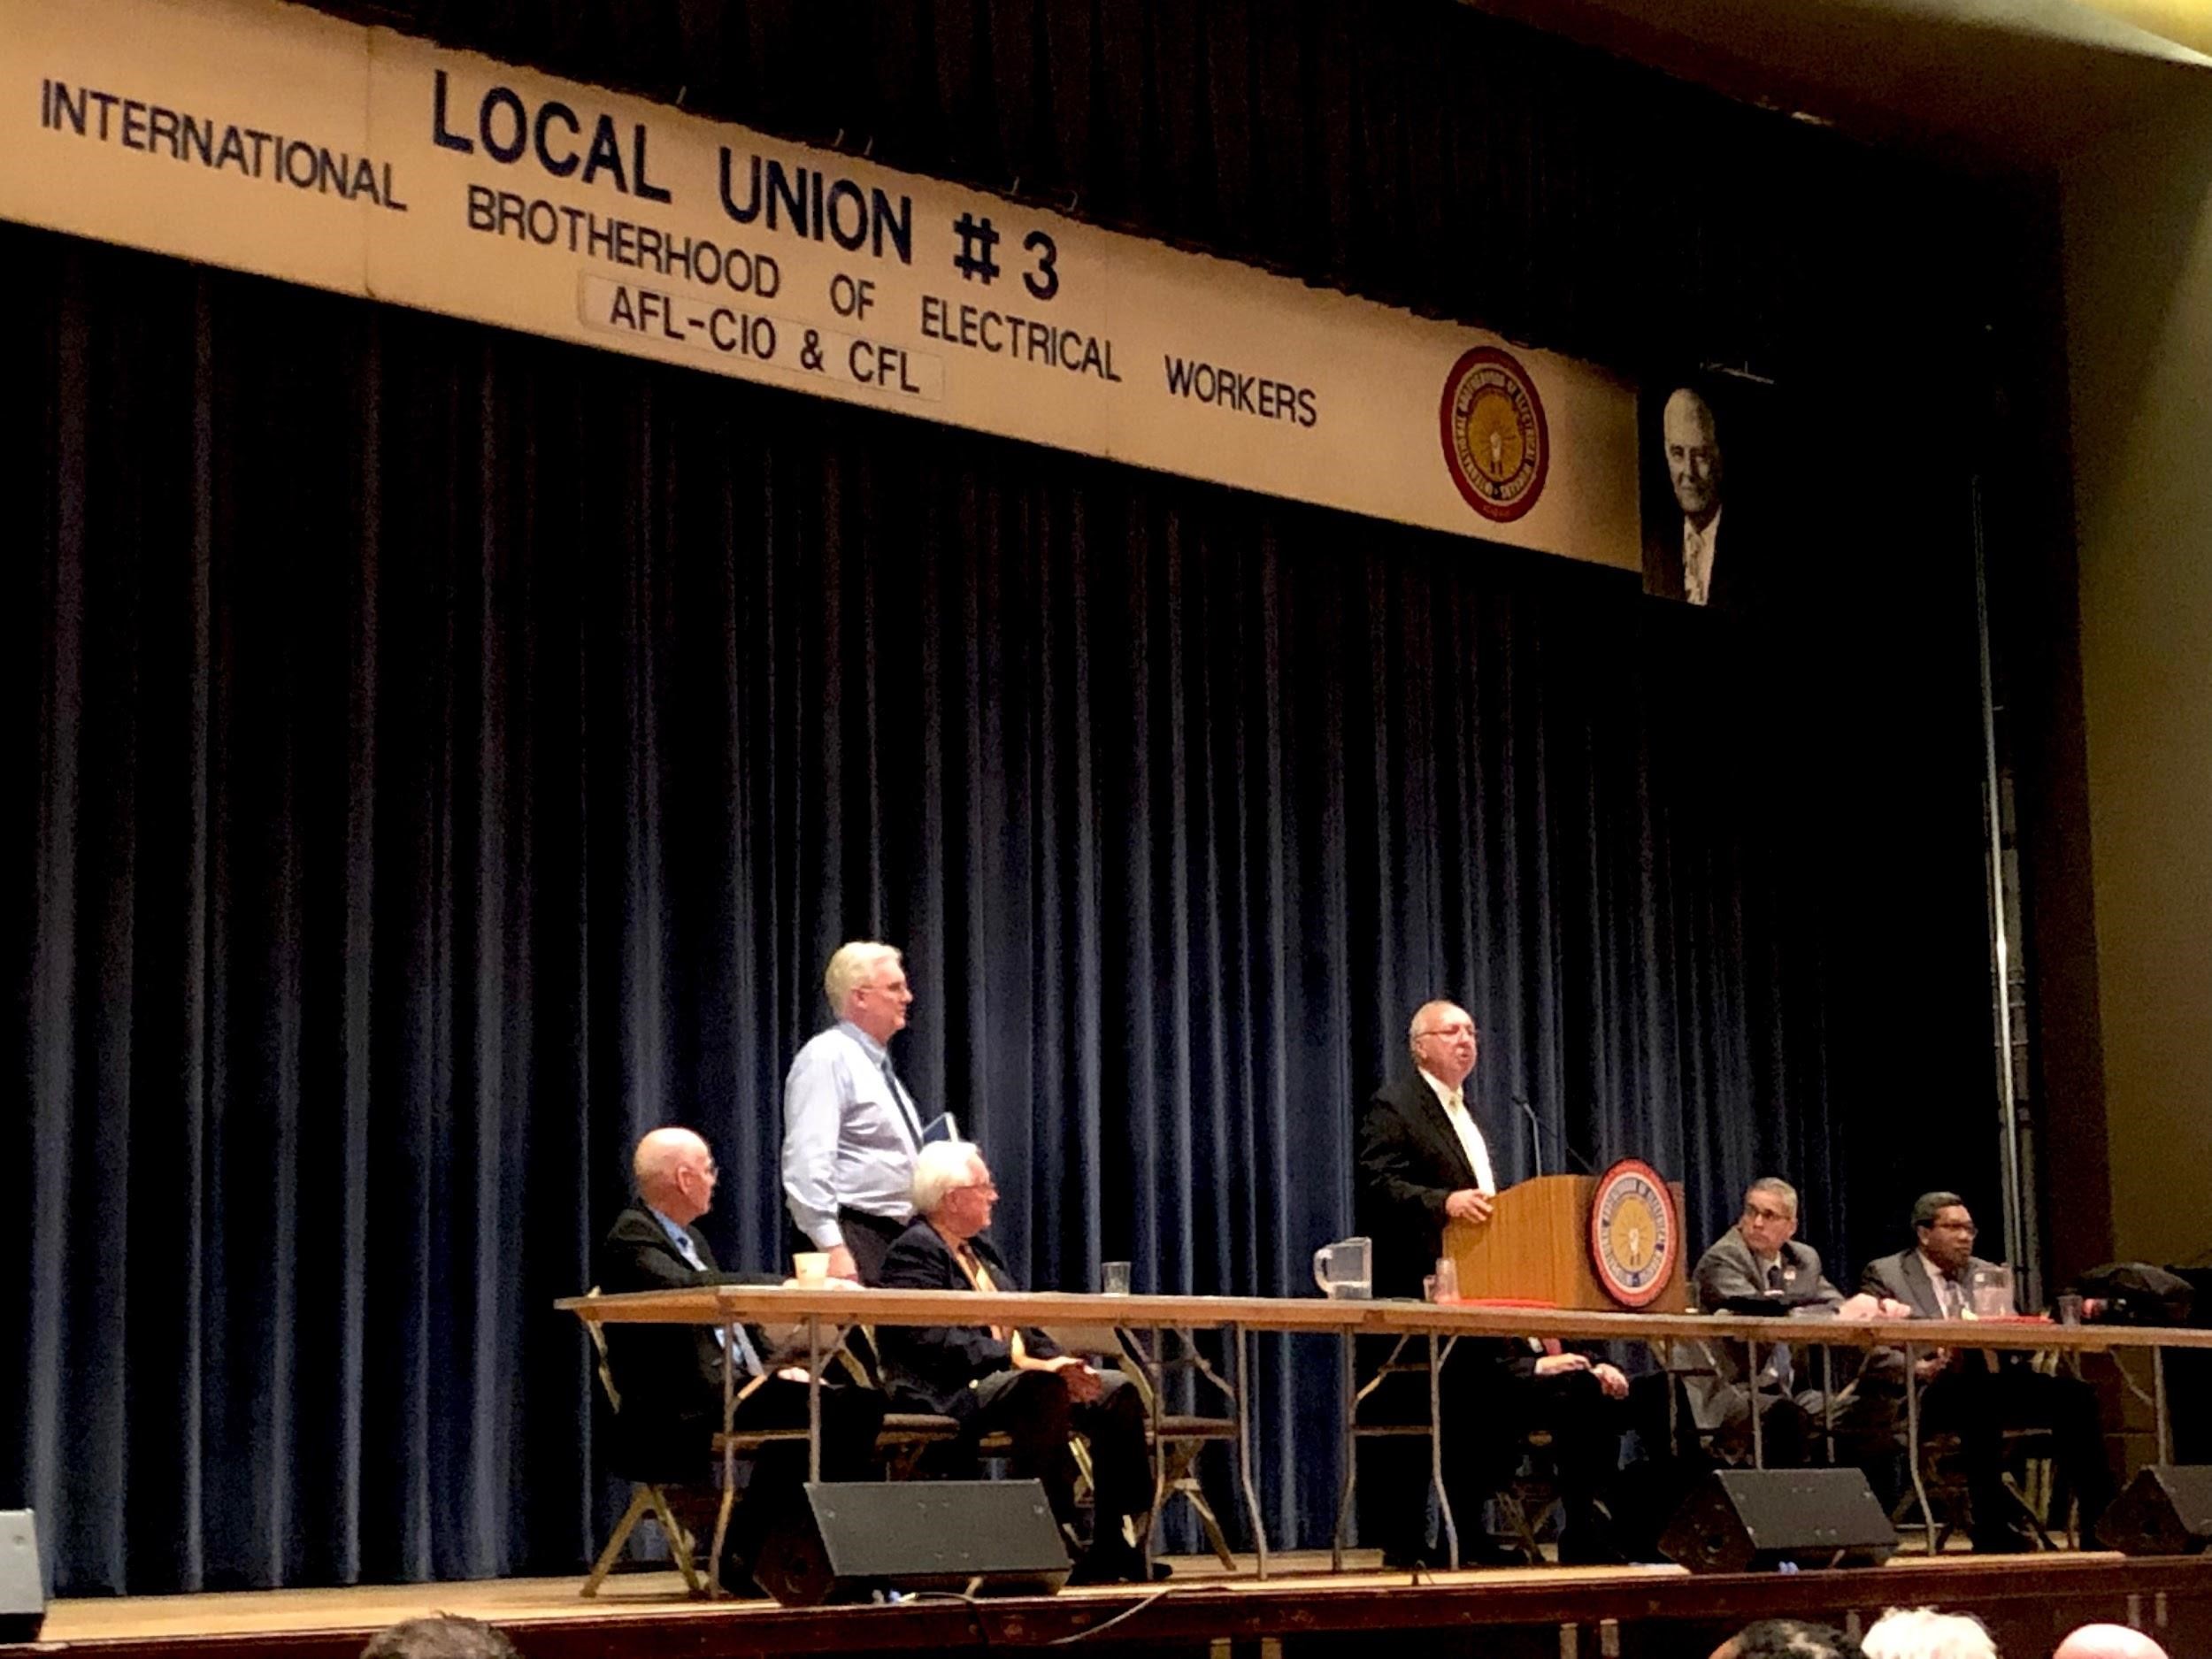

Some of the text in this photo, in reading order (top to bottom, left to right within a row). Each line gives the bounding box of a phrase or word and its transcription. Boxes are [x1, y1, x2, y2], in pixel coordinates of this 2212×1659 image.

[41, 77, 1318, 429] INTERNATIONAL BROTHERHOOD OF ELECTRICAL WORKERS
[432, 68, 673, 205] LOCAL
[718, 145, 912, 266] UNION
[609, 285, 922, 395] AFL-CIO & CFL
